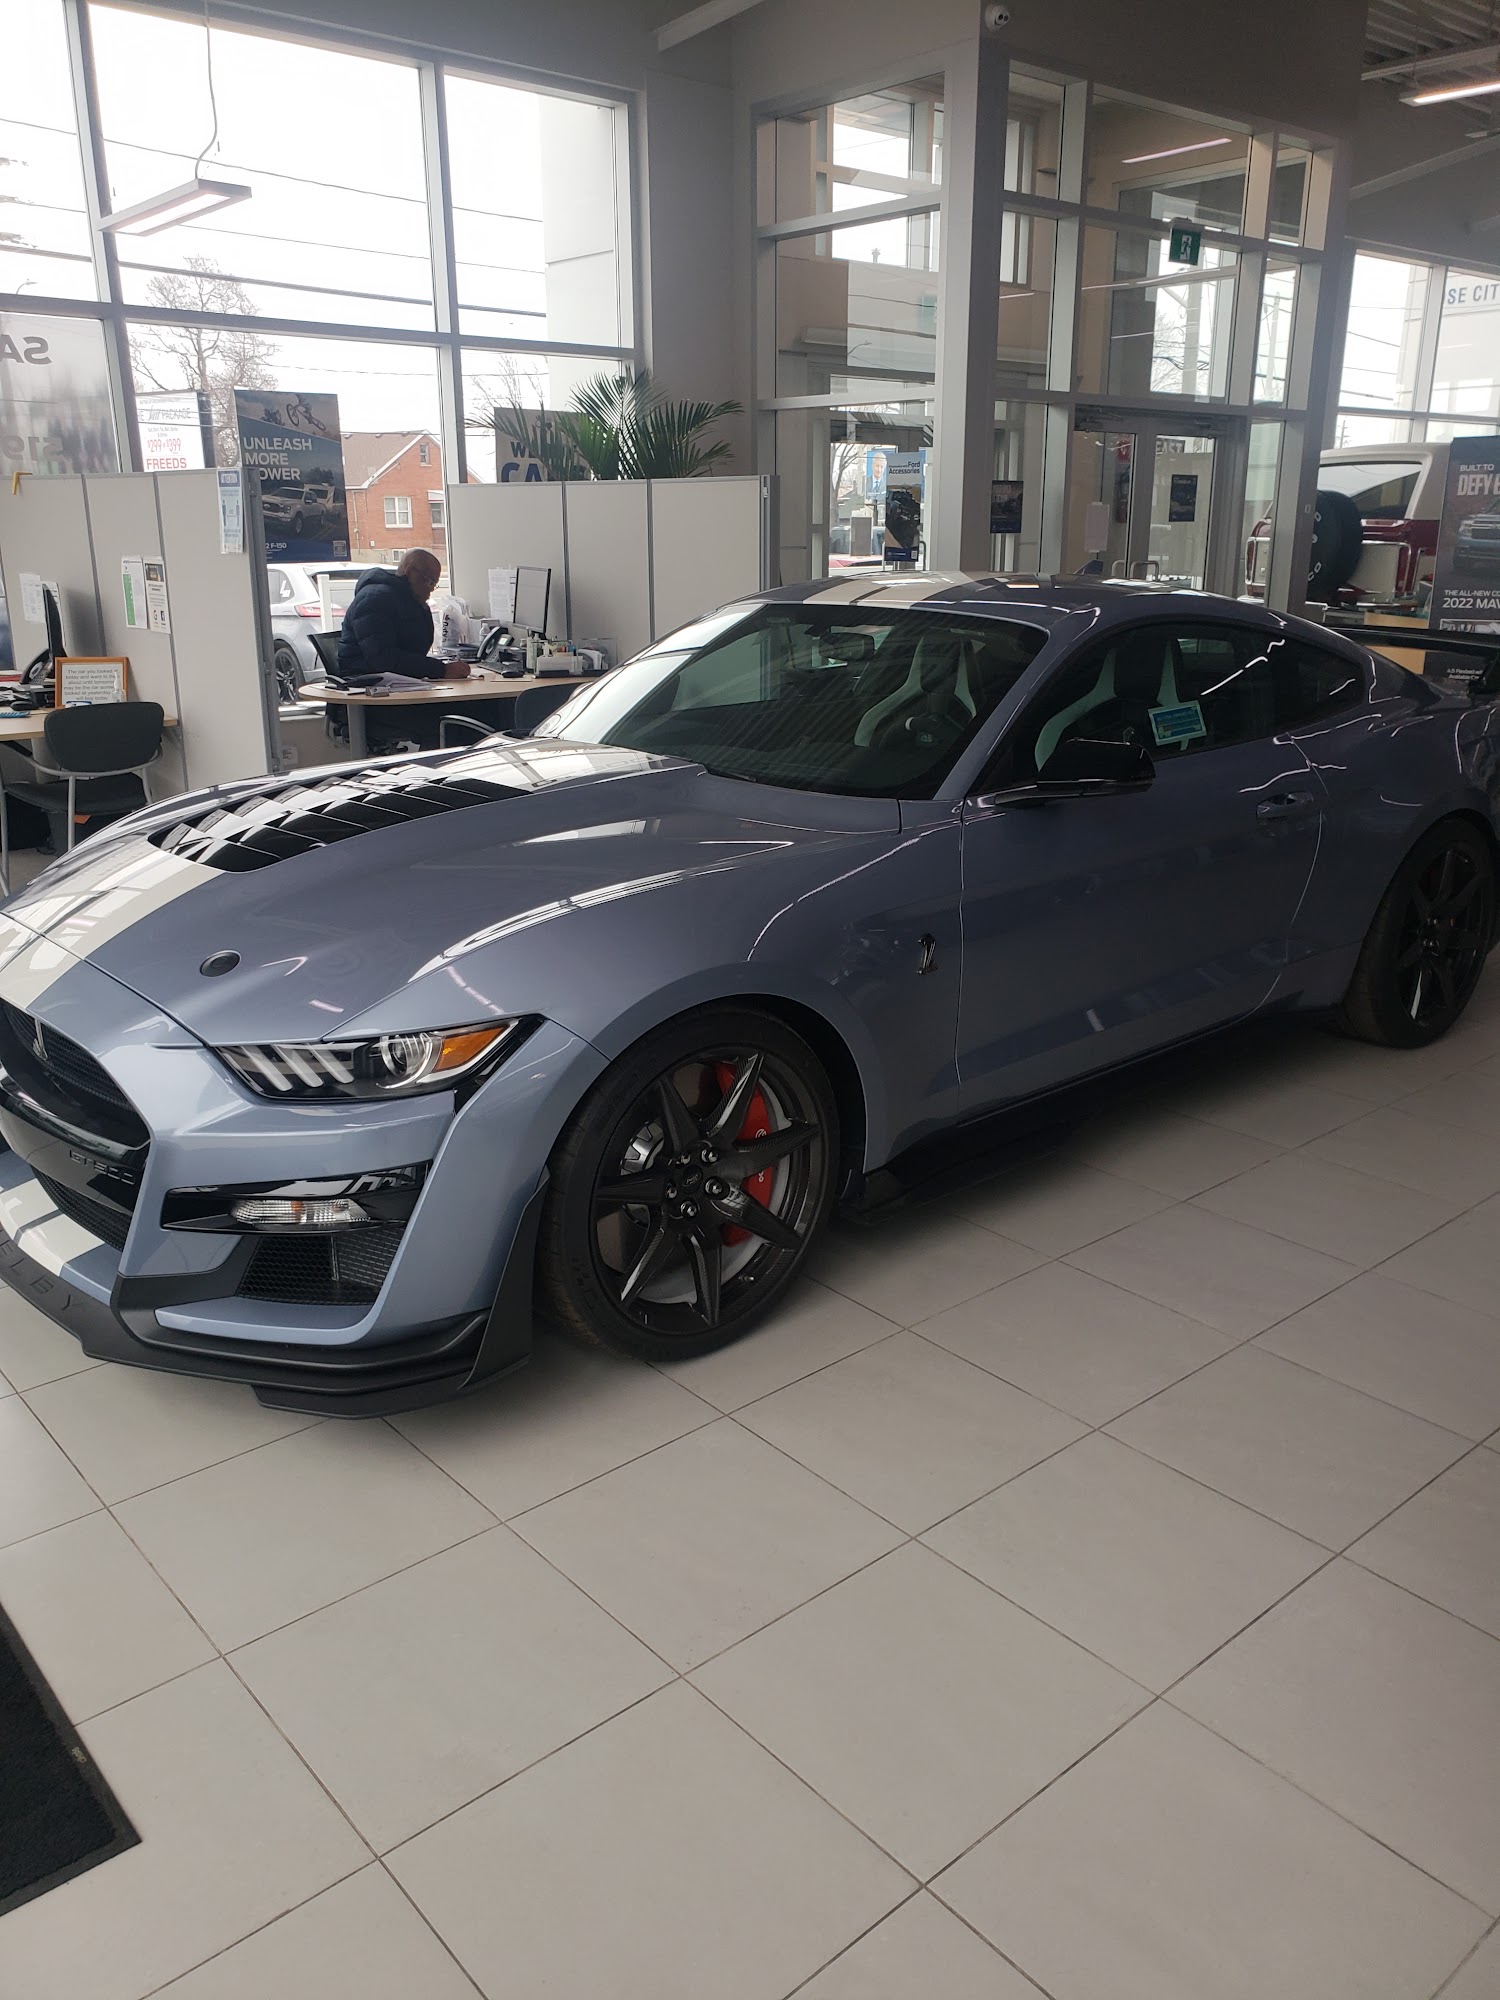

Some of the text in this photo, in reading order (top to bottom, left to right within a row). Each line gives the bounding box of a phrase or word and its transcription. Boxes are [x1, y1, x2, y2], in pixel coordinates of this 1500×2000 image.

[243, 437, 312, 450] UNLEASH
[146, 457, 187, 470] FREEDS
[245, 452, 289, 466] MORE
[260, 467, 301, 480] OWER
[888, 467, 920, 475] Accessories
[1460, 464, 1482, 472] BUILT
[1457, 473, 1493, 496] DEFY
[1442, 597, 1474, 609] 2022
[69, 1149, 135, 1186] GT500
[0, 1236, 83, 1311] ELBY
